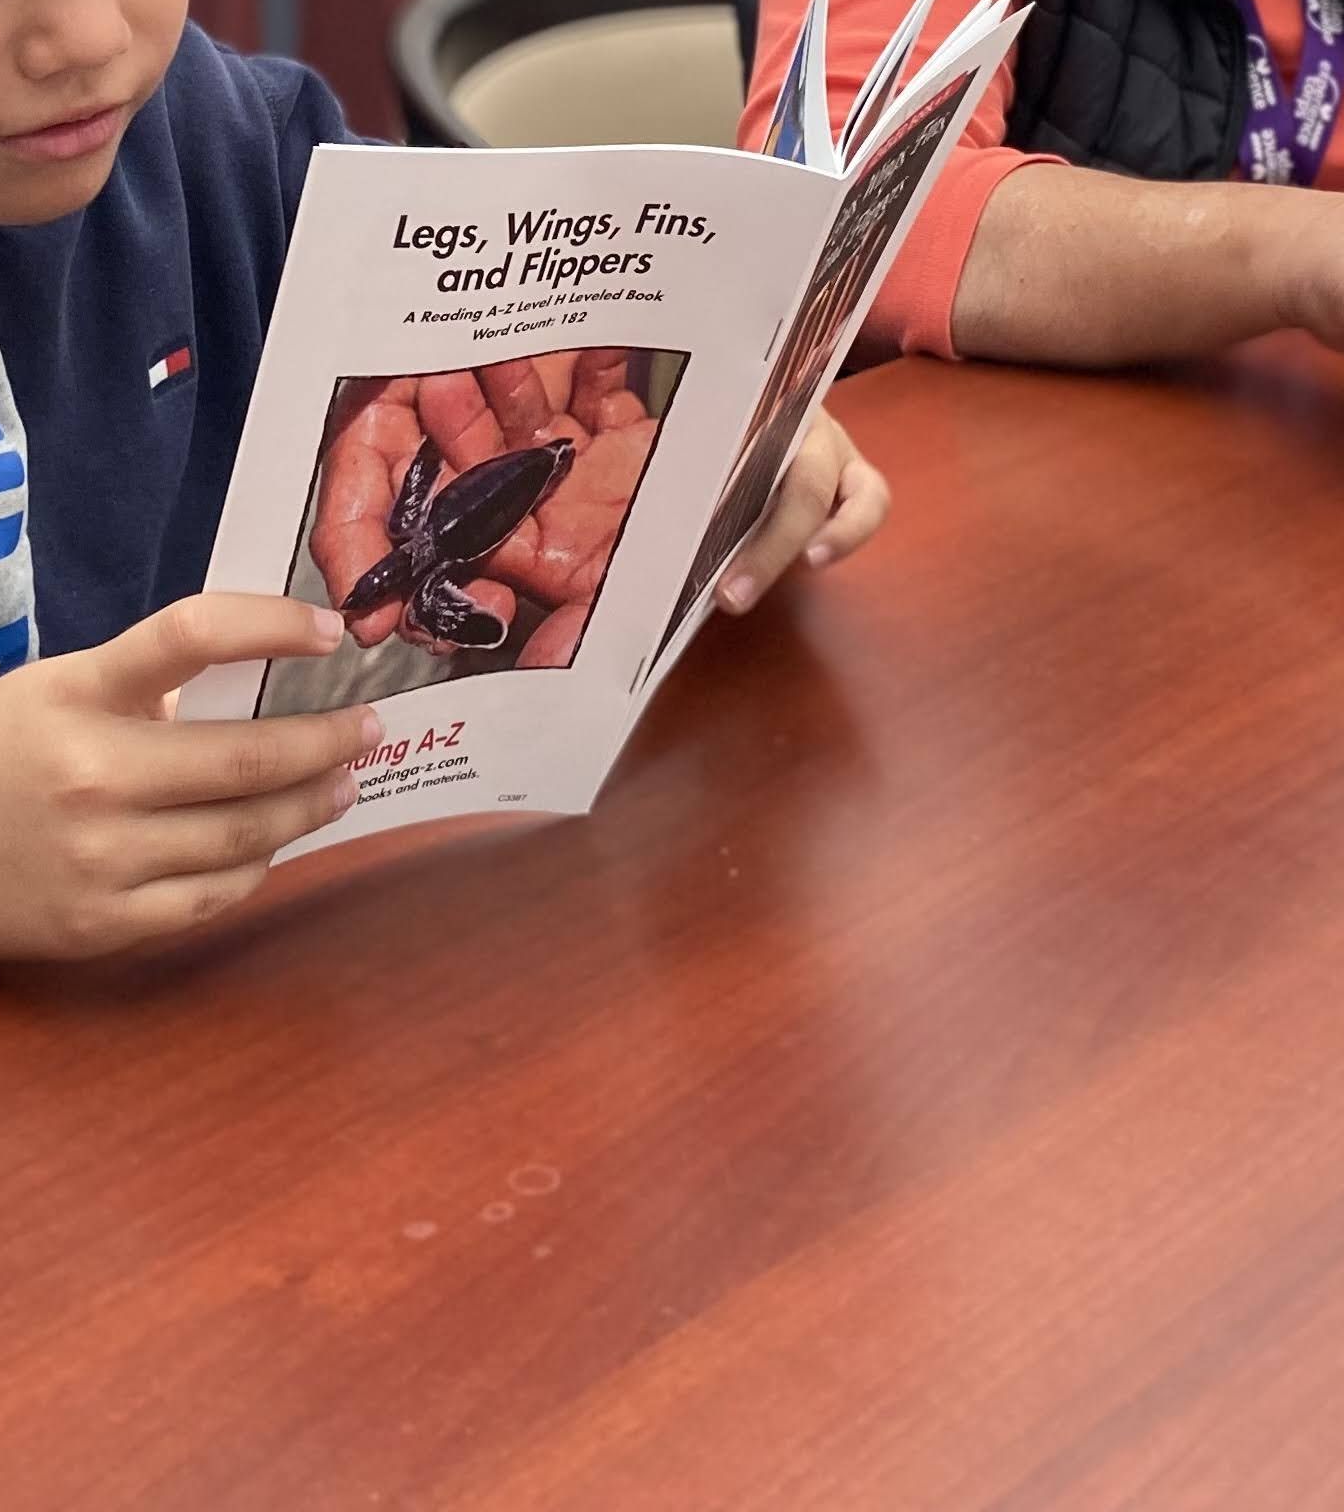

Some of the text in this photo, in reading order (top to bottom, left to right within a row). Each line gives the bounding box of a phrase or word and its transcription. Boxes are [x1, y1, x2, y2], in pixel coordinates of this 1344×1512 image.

[393, 203, 720, 259] Legs, Wings, Fins,
[437, 247, 654, 293] and Flippers
[402, 288, 665, 324] A Reading A-Z Level H Leveled Book
[472, 311, 588, 341] Word Count: 182
[347, 721, 466, 771] ding A-Z
[359, 755, 469, 790] eadinga-z.com
[356, 788, 392, 806] books
[395, 778, 420, 794] and
